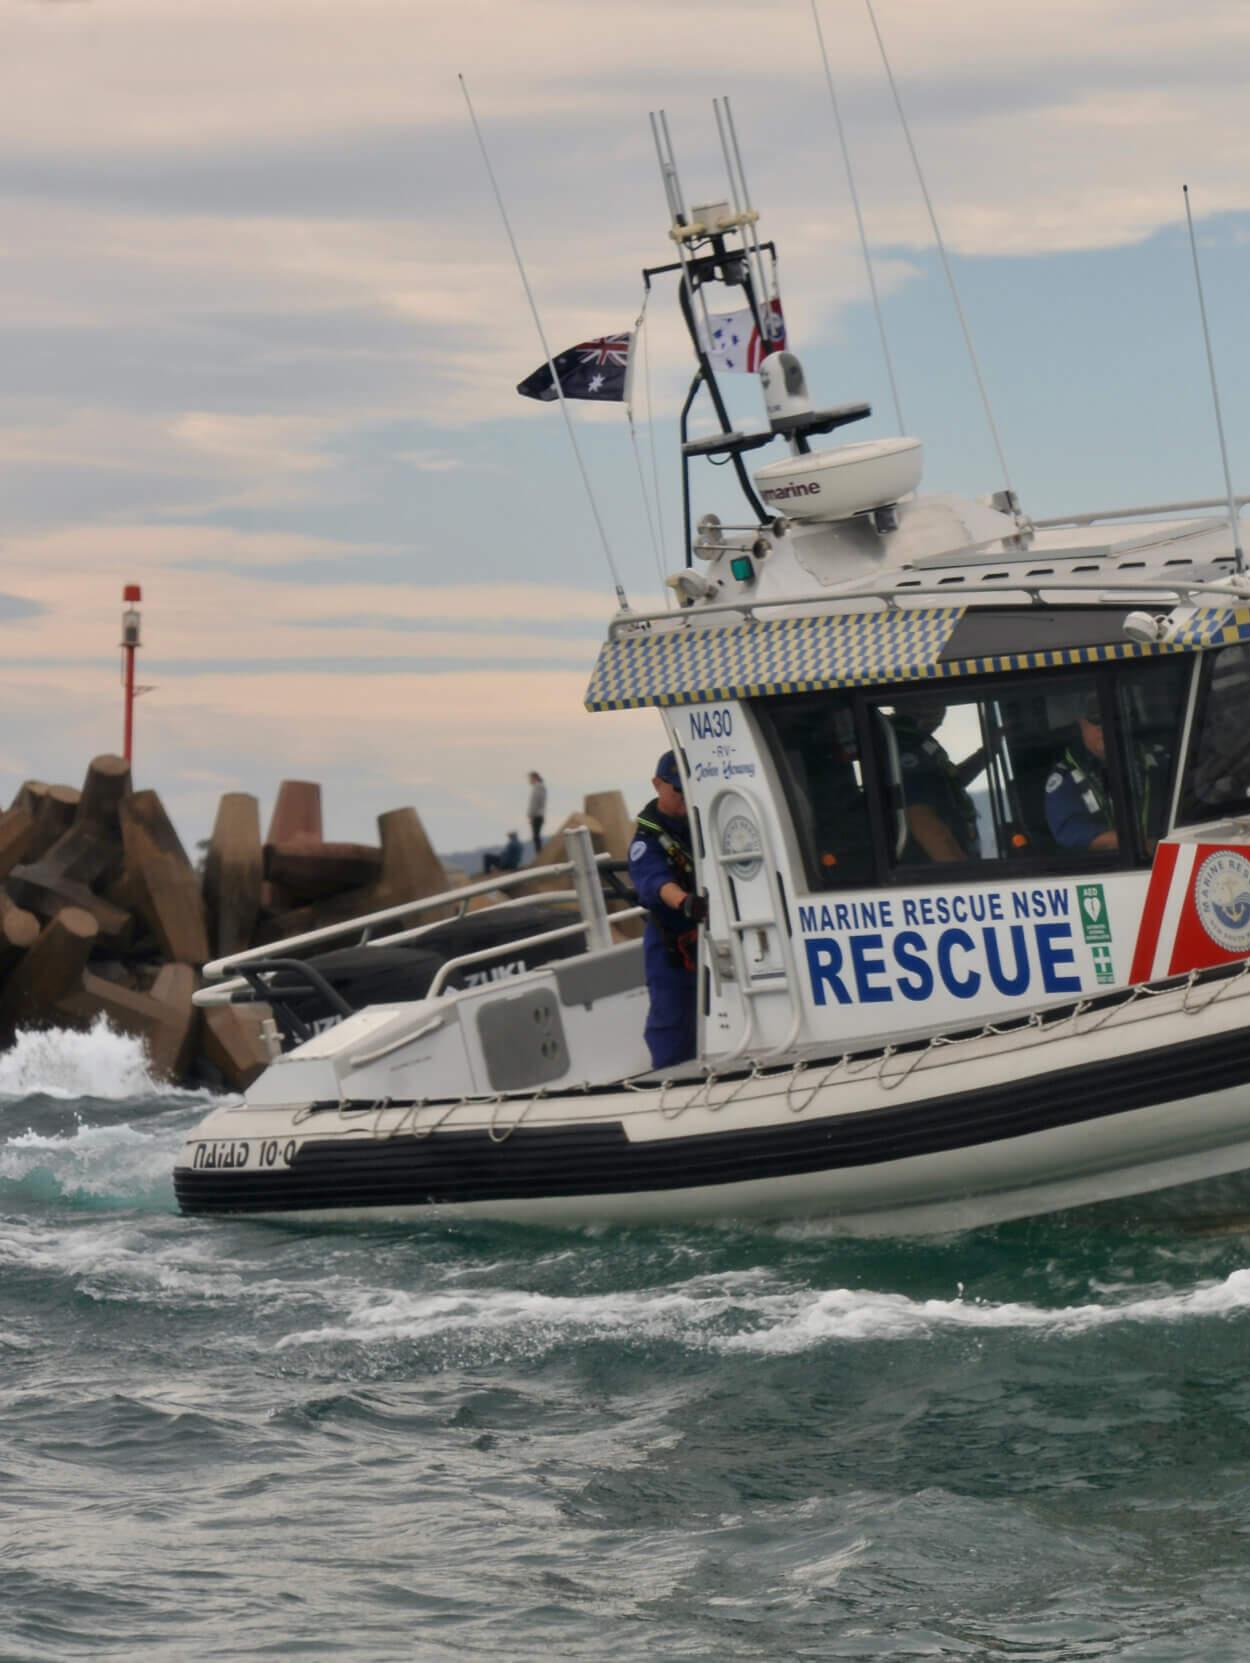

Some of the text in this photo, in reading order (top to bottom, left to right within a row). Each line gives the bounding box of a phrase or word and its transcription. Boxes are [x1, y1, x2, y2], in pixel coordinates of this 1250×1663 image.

[690, 709, 732, 740] NA30
[799, 888, 1069, 932] MARINE RESCUE NSW
[804, 923, 1082, 1006] RESCUE
